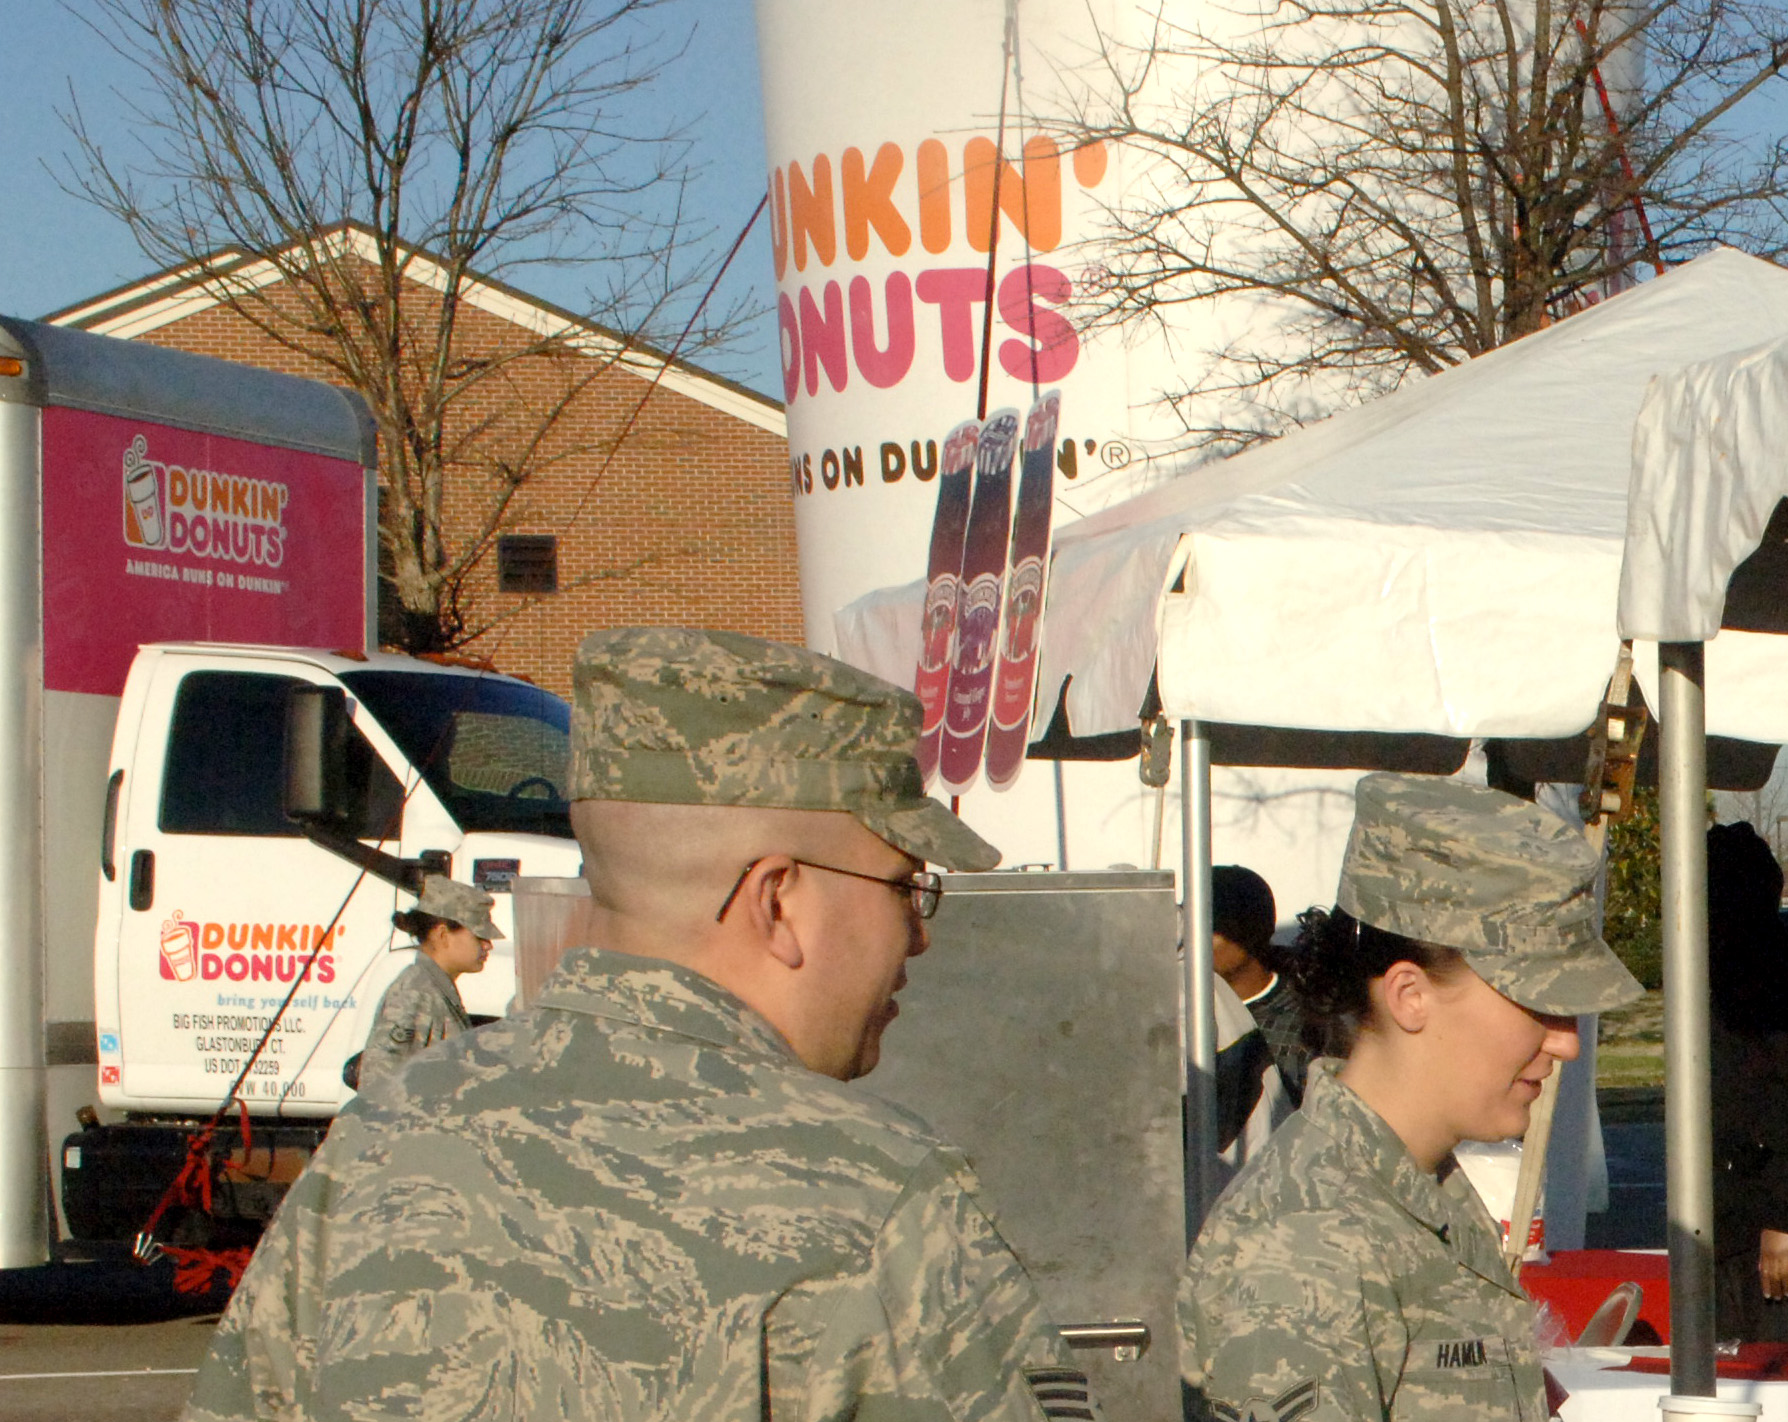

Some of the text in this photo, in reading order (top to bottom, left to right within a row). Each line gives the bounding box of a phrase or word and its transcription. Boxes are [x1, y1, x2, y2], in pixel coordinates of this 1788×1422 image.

[769, 135, 1107, 281] UNKIN'
[778, 264, 1079, 405] ONUTS
[821, 446, 864, 490] ON
[168, 466, 288, 523] DUNKIN'
[168, 511, 283, 567] DONUTS
[126, 559, 179, 580] AMERICA
[183, 568, 213, 585] RUNS
[217, 572, 234, 588] ON
[202, 922, 345, 952] DUNKIN'
[202, 953, 336, 983] DONUTS
[217, 993, 255, 1010] bring
[323, 995, 357, 1010] back
[173, 1014, 190, 1029] BIG
[193, 1014, 214, 1030] FISH
[284, 1017, 305, 1033] LLC.
[271, 1038, 285, 1054] CT.
[205, 1058, 217, 1073] US
[220, 1058, 240, 1073] DOT
